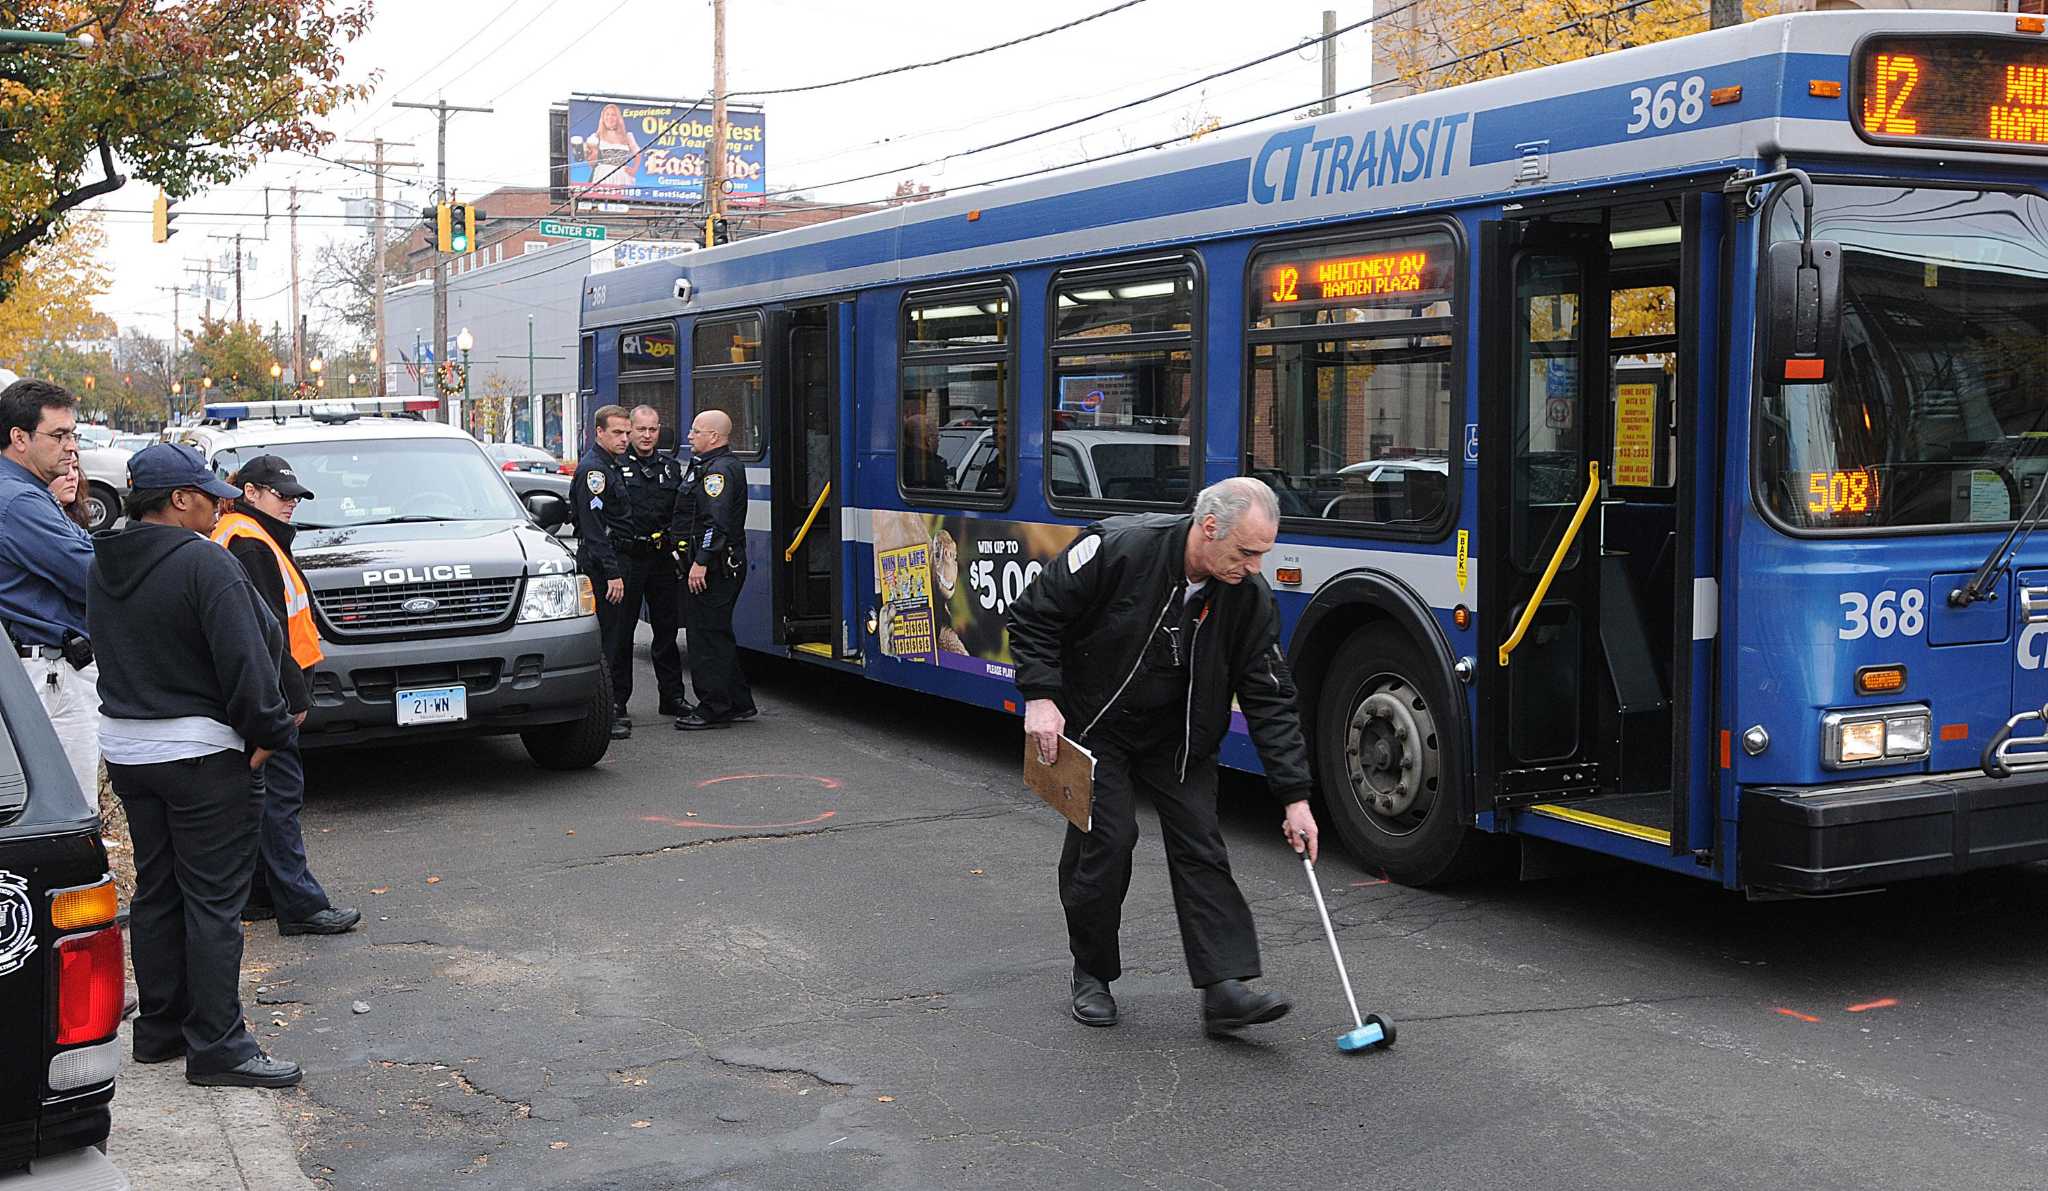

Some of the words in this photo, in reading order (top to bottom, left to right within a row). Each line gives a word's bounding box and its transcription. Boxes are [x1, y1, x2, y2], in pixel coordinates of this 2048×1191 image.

[1626, 75, 1704, 135] 368
[1864, 55, 1919, 134] J2
[623, 108, 672, 118] Experience
[642, 116, 761, 142] Oktobefest
[657, 135, 675, 146] All
[645, 149, 704, 176] East
[726, 154, 761, 181] ide
[545, 224, 582, 237] CENTER
[585, 226, 600, 238] ST.
[1272, 267, 1299, 302] J2
[1319, 256, 1396, 280] WHITNEY
[1398, 253, 1426, 274] AV
[1321, 279, 1372, 298] HAMDEN
[1375, 274, 1420, 293] PLAZA
[1808, 471, 1869, 513] 508
[977, 540, 994, 554] WIN
[994, 541, 1005, 554] UP
[1006, 541, 1018, 553] TO
[537, 559, 562, 574] 21
[881, 556, 896, 571] WIN
[909, 551, 926, 567] LIFE
[363, 564, 473, 587] POLICE
[411, 599, 429, 611] Ford
[1839, 588, 1924, 640] 368
[2016, 623, 2048, 669] C
[986, 663, 1002, 676] PLEASE
[1002, 666, 1013, 678] PLAY
